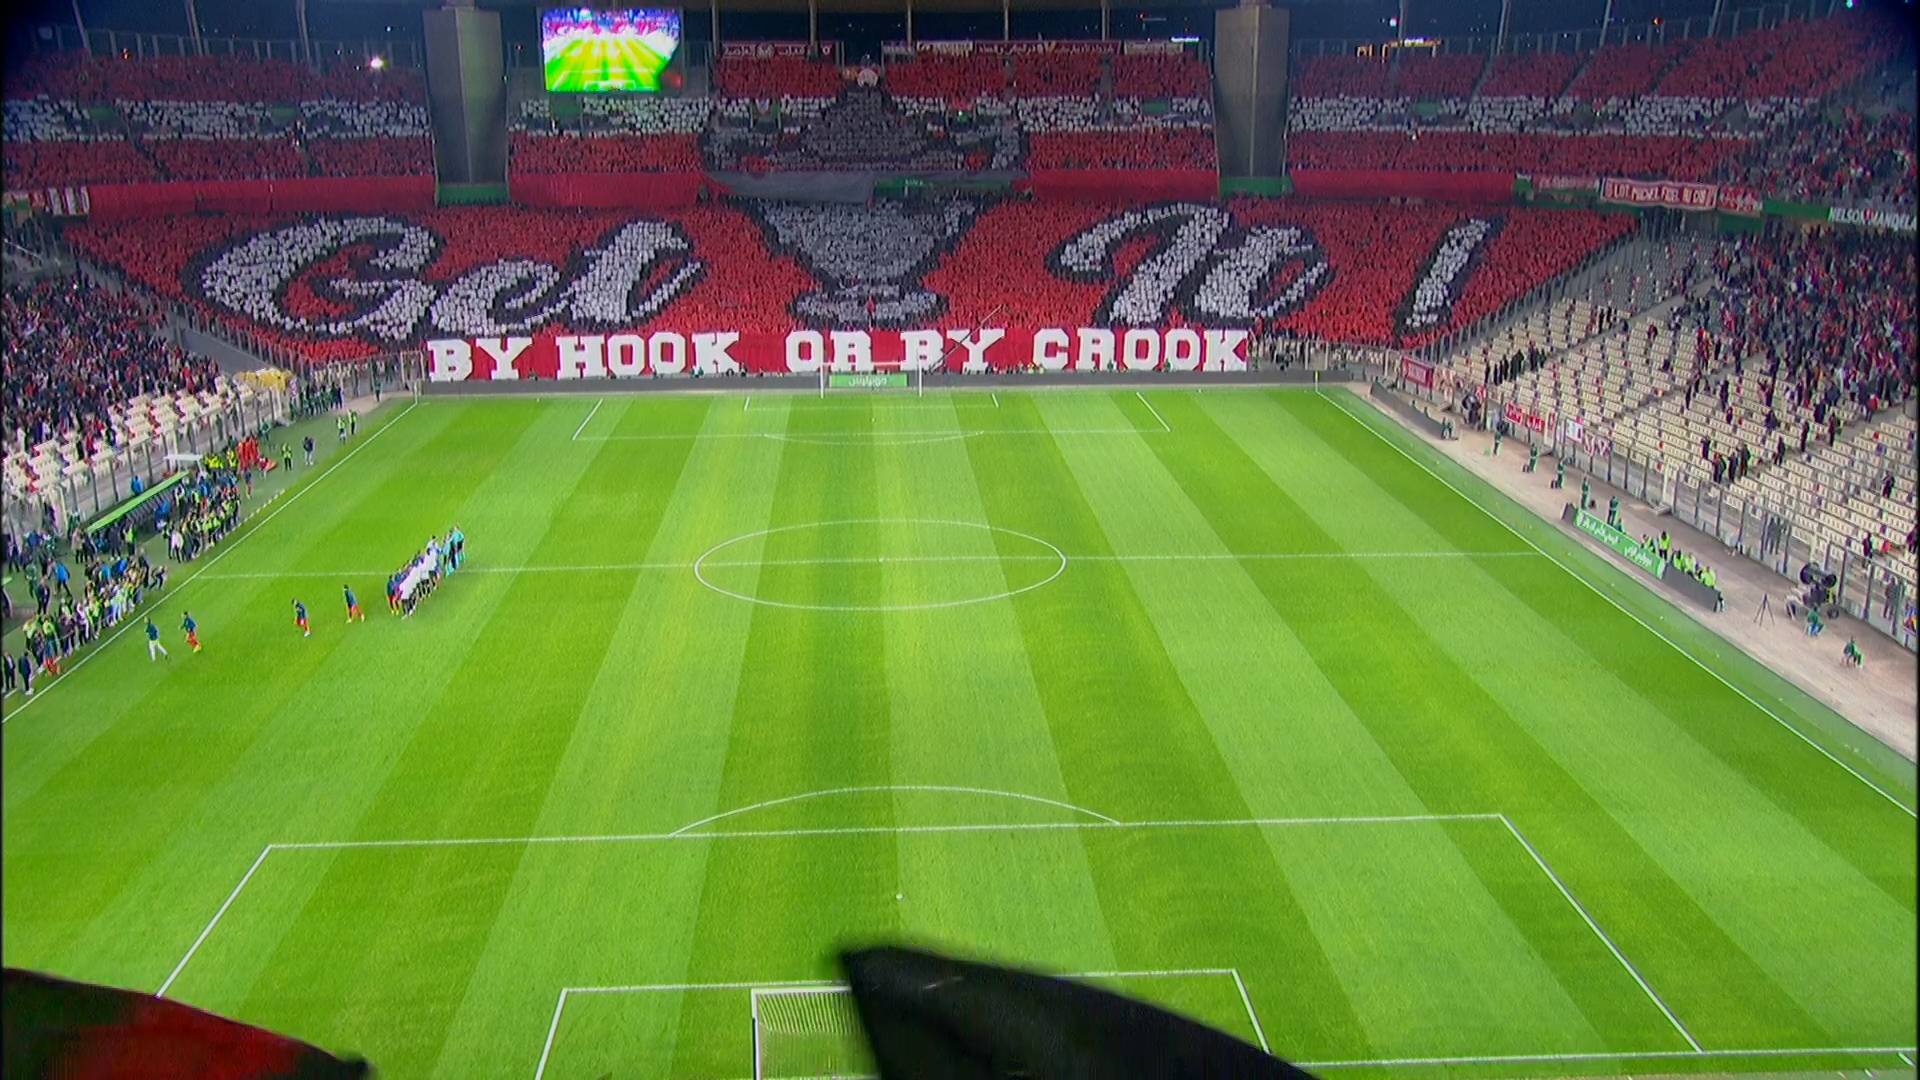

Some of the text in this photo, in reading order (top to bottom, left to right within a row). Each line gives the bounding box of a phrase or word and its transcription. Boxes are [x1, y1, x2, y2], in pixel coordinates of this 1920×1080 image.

[1828, 206, 1866, 225] NELSON
[192, 214, 704, 344] Get
[1055, 202, 1330, 328] It
[427, 327, 1248, 381] BY HOOK OR BY CROOK
